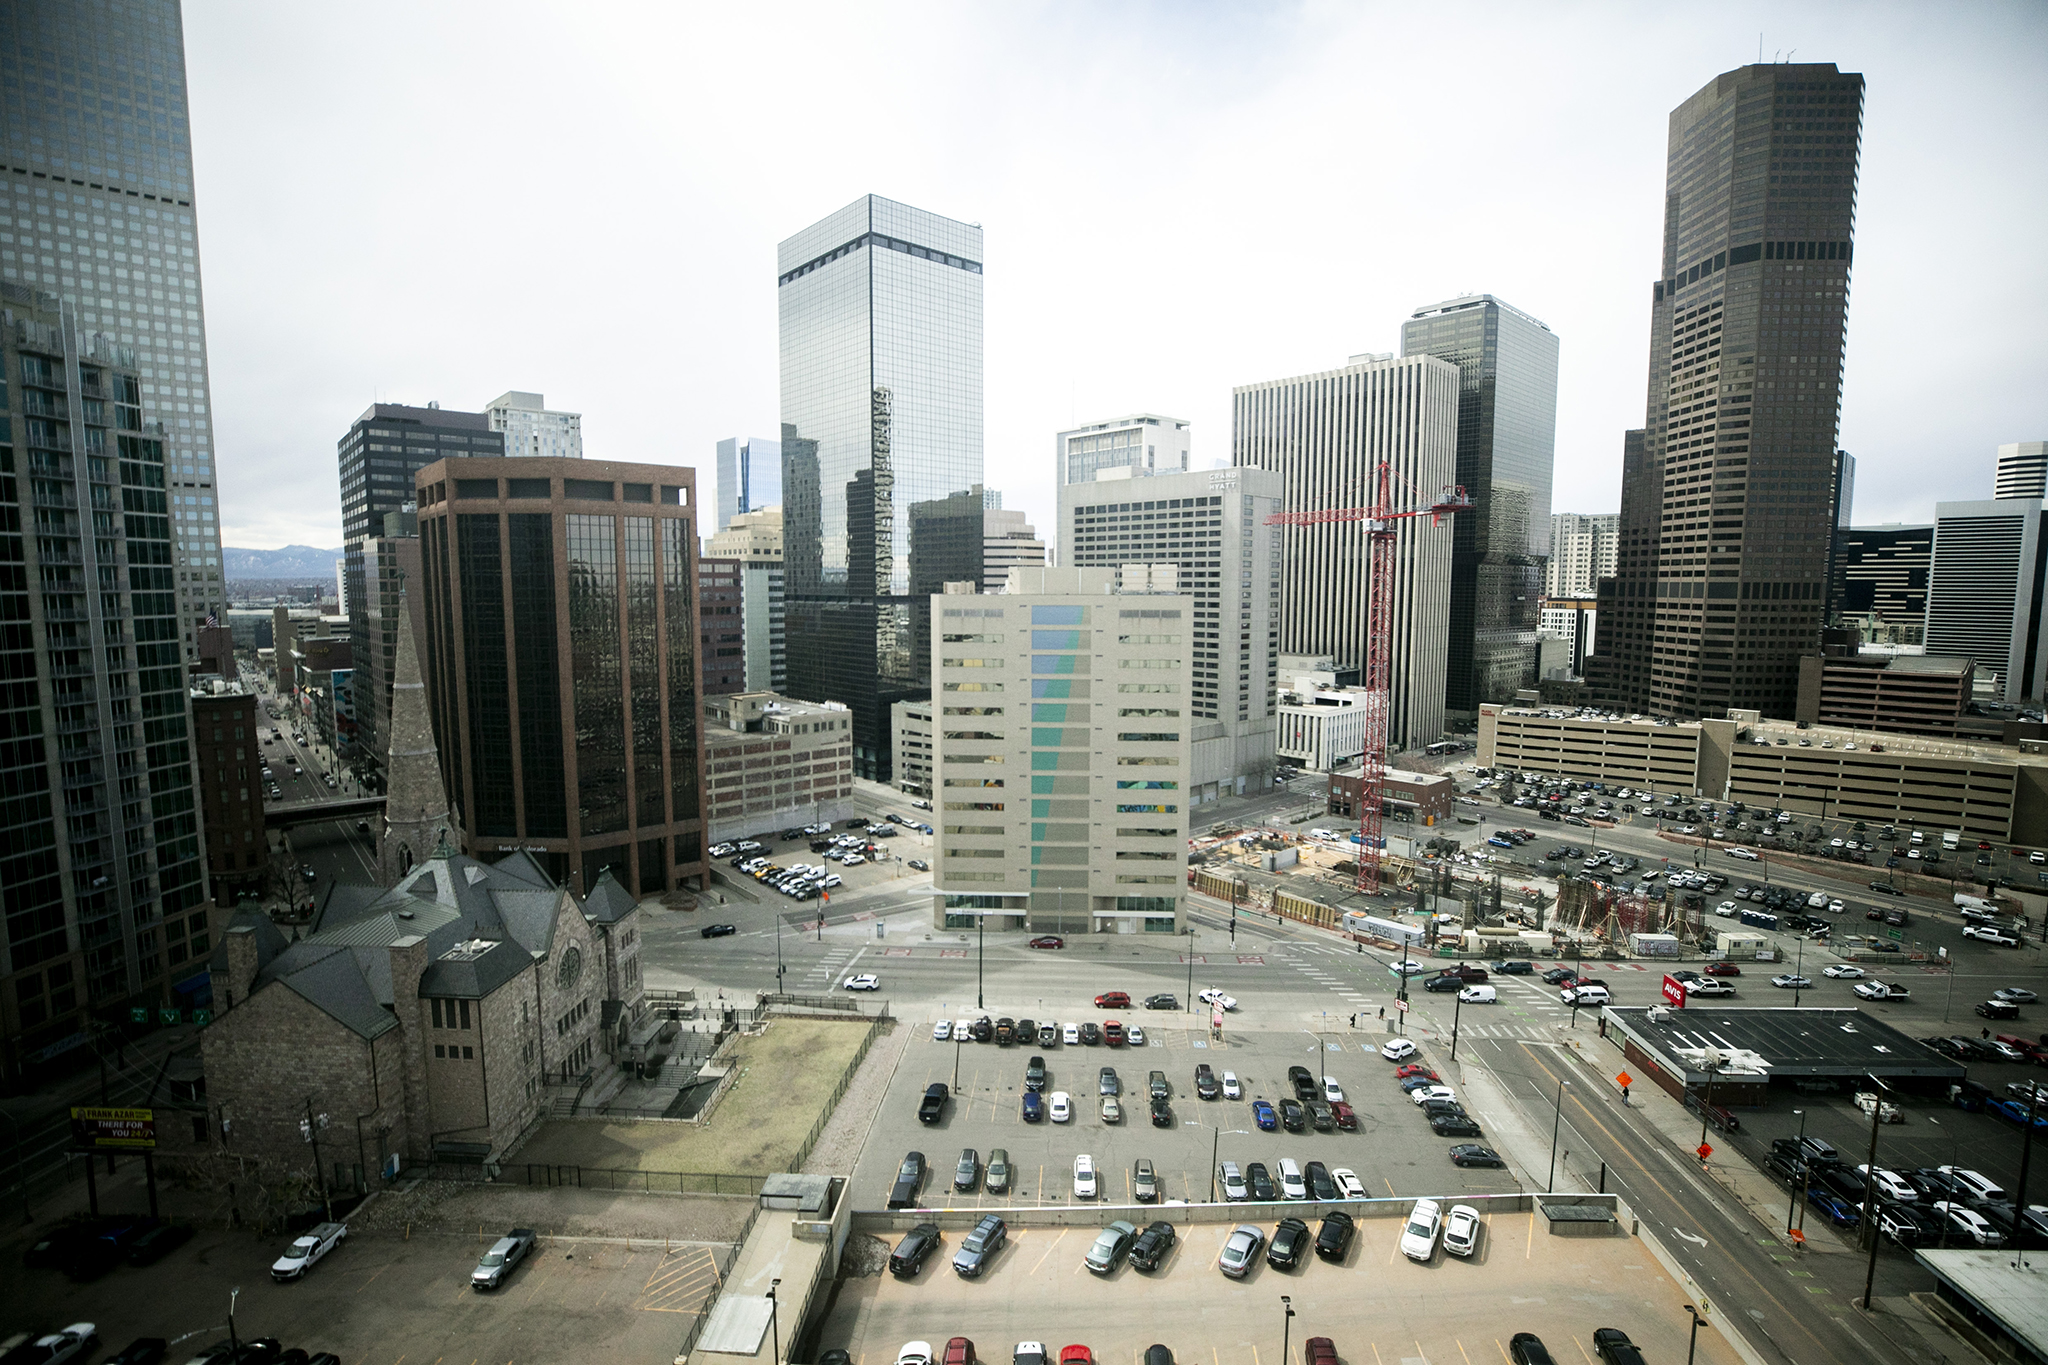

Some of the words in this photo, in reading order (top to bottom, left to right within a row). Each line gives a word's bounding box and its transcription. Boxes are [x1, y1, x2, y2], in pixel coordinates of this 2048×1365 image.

[1209, 472, 1237, 480] GRAND
[1209, 482, 1236, 490] HYATT
[1664, 982, 1681, 1000] AVIS
[87, 1110, 113, 1118] FRANK
[114, 1110, 135, 1119] AZAR
[98, 1121, 125, 1129] THERE
[125, 1121, 144, 1129] FOR
[112, 1129, 130, 1137] YOU
[130, 1129, 150, 1138] 24/7
